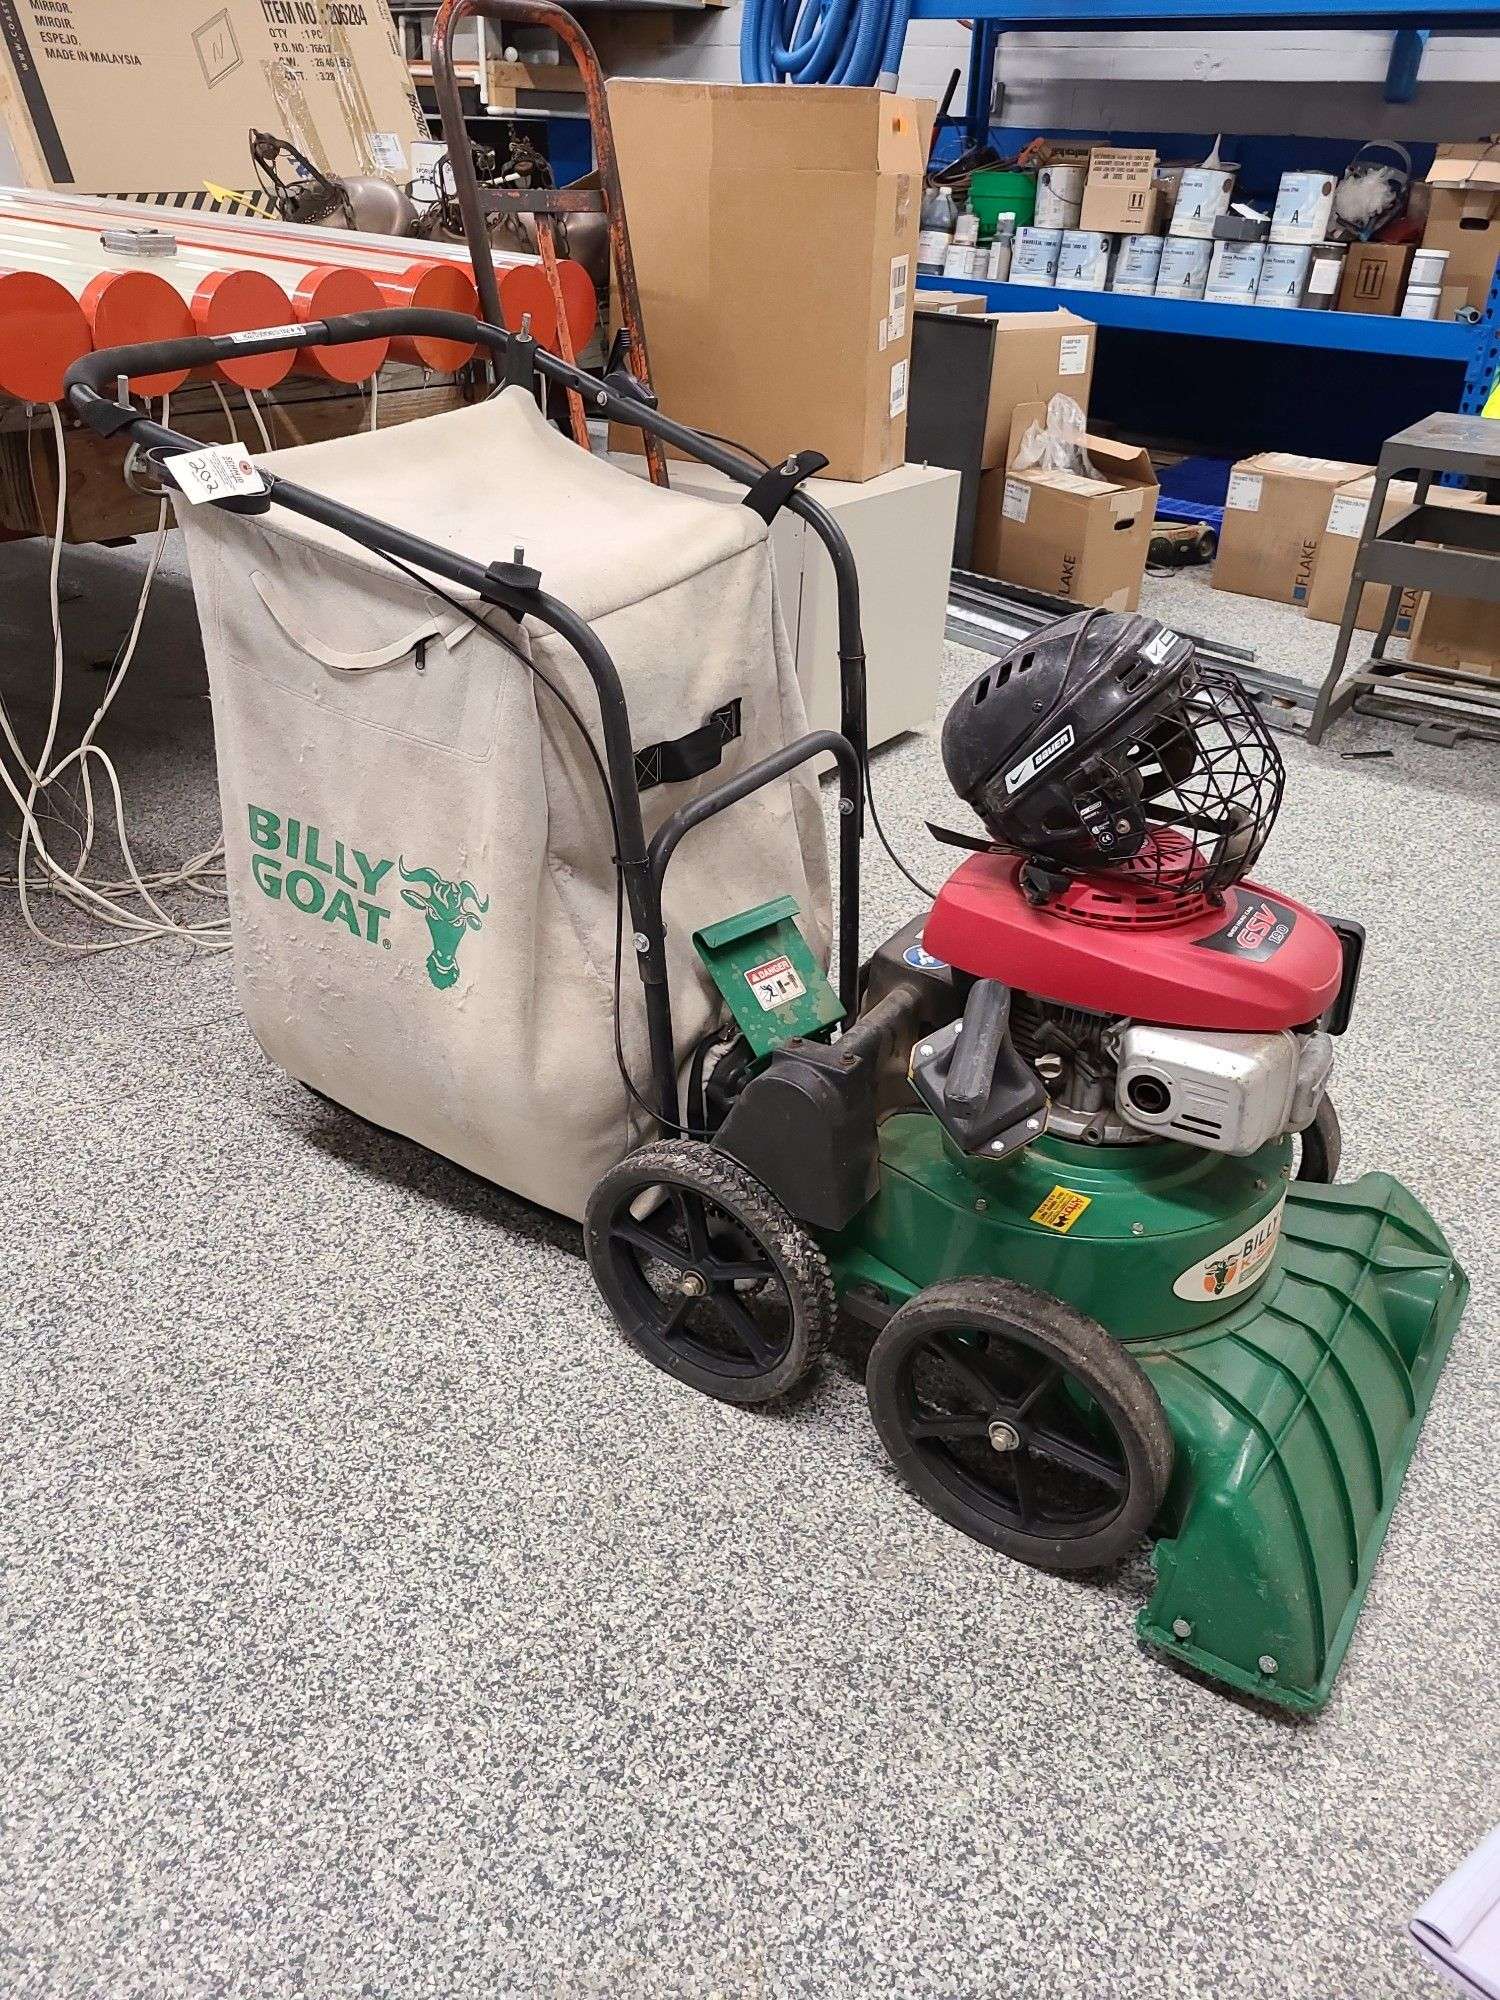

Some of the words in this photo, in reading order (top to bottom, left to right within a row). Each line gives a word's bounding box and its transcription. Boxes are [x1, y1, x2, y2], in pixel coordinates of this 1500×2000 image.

[29, 0, 73, 14] MIRROR.
[260, 0, 297, 24] ITEM
[34, 14, 75, 29] MIROIR.
[40, 31, 81, 46] ESPEJO.
[45, 48, 76, 61] MADE
[77, 51, 90, 62] IN
[89, 52, 143, 66] MALAYSIA
[406, 92, 432, 140] 206284
[1193, 205, 1201, 217] A
[1291, 210, 1299, 223] A
[1074, 265, 1082, 277] A
[1183, 272, 1191, 285] A
[1248, 278, 1255, 291] A
[1287, 281, 1295, 294] A
[188, 457, 219, 494] 202
[1295, 539, 1318, 586] FLAKE
[1058, 553, 1076, 595] LAKE
[1399, 590, 1419, 618] FLA
[1034, 733, 1069, 766] BAUER
[247, 803, 395, 896] BILLY
[1236, 902, 1278, 950] GSV
[1268, 924, 1289, 945] 190
[757, 959, 790, 980] DANGER
